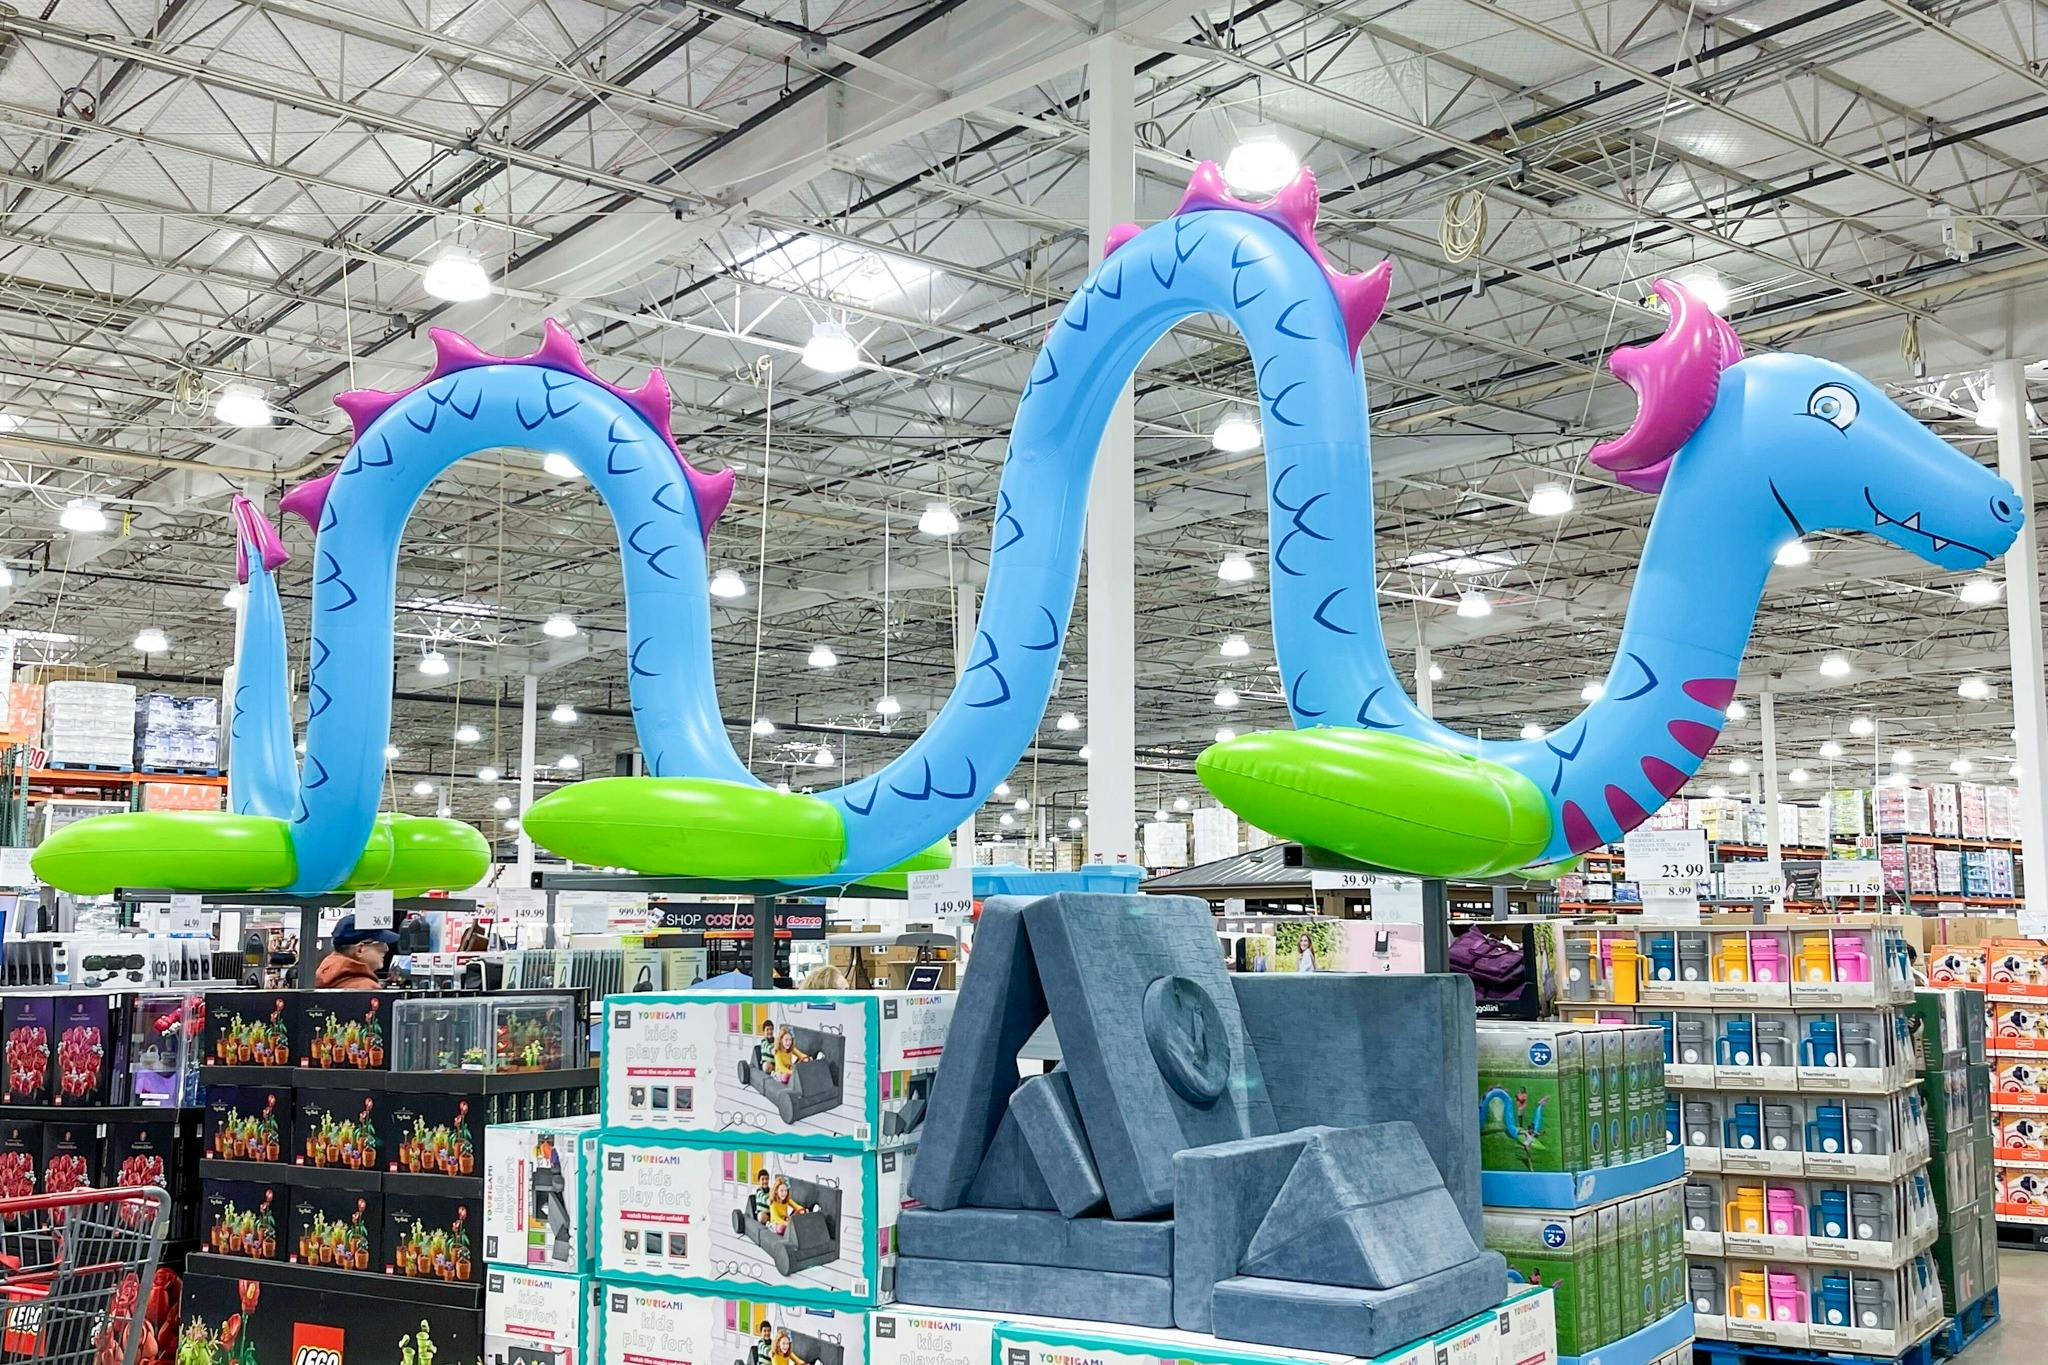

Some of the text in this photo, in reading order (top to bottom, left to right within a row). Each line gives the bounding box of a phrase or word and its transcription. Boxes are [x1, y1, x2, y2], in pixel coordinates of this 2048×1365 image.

[1859, 837, 1874, 848] 300
[1662, 864, 1704, 878] 23.99
[1342, 874, 1376, 888] 39.99
[1668, 886, 1691, 896] 8.99
[1751, 885, 1781, 895] 12.49
[1849, 883, 1880, 894] 11.59
[619, 907, 647, 917] 999.99
[935, 900, 971, 913] 149.99
[514, 908, 545, 918] 149.99
[373, 916, 392, 926] 36.99
[666, 914, 701, 926] SHOP
[786, 915, 823, 926] COSTCO
[906, 996, 942, 1006] YOURIGAMI
[638, 1011, 687, 1020] YOURIGAMI
[644, 1023, 678, 1042] kids
[626, 1042, 697, 1063] play fort
[1534, 1052, 1548, 1062] 2+
[632, 1155, 680, 1165] YOURIGAMI
[638, 1167, 672, 1187] kids
[619, 1186, 692, 1207] play fort
[1547, 1234, 1561, 1244] 2+
[512, 1277, 553, 1289] YOURIGAMI
[635, 1297, 683, 1311] YOURIGAMI
[640, 1311, 674, 1332] kids
[908, 1319, 961, 1332] YOURIGAMI
[622, 1329, 694, 1353] play fort
[917, 1332, 953, 1352] kids
